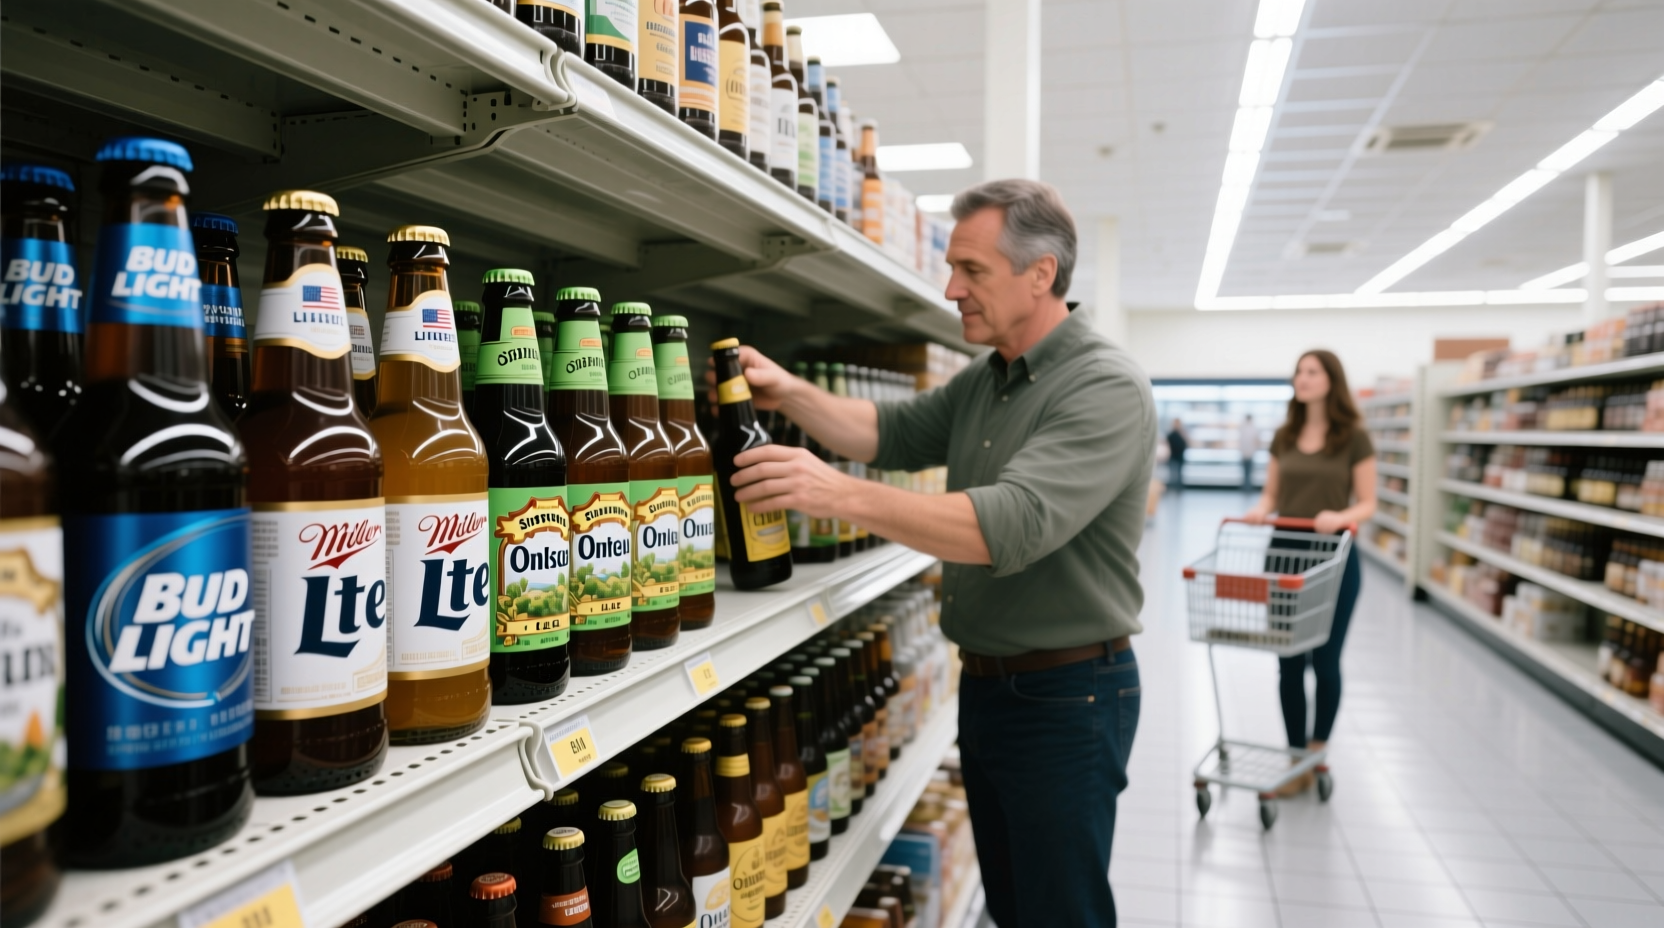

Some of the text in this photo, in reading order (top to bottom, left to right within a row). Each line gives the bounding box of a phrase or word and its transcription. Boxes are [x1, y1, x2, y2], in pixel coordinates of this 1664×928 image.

[4, 258, 75, 286] BUD
[111, 271, 202, 302] LIGHT
[126, 245, 197, 276] BUD
[133, 568, 249, 625] BUD
[293, 574, 386, 658] Lte
[413, 558, 490, 632] Lte
[108, 610, 256, 674] LIGHT
